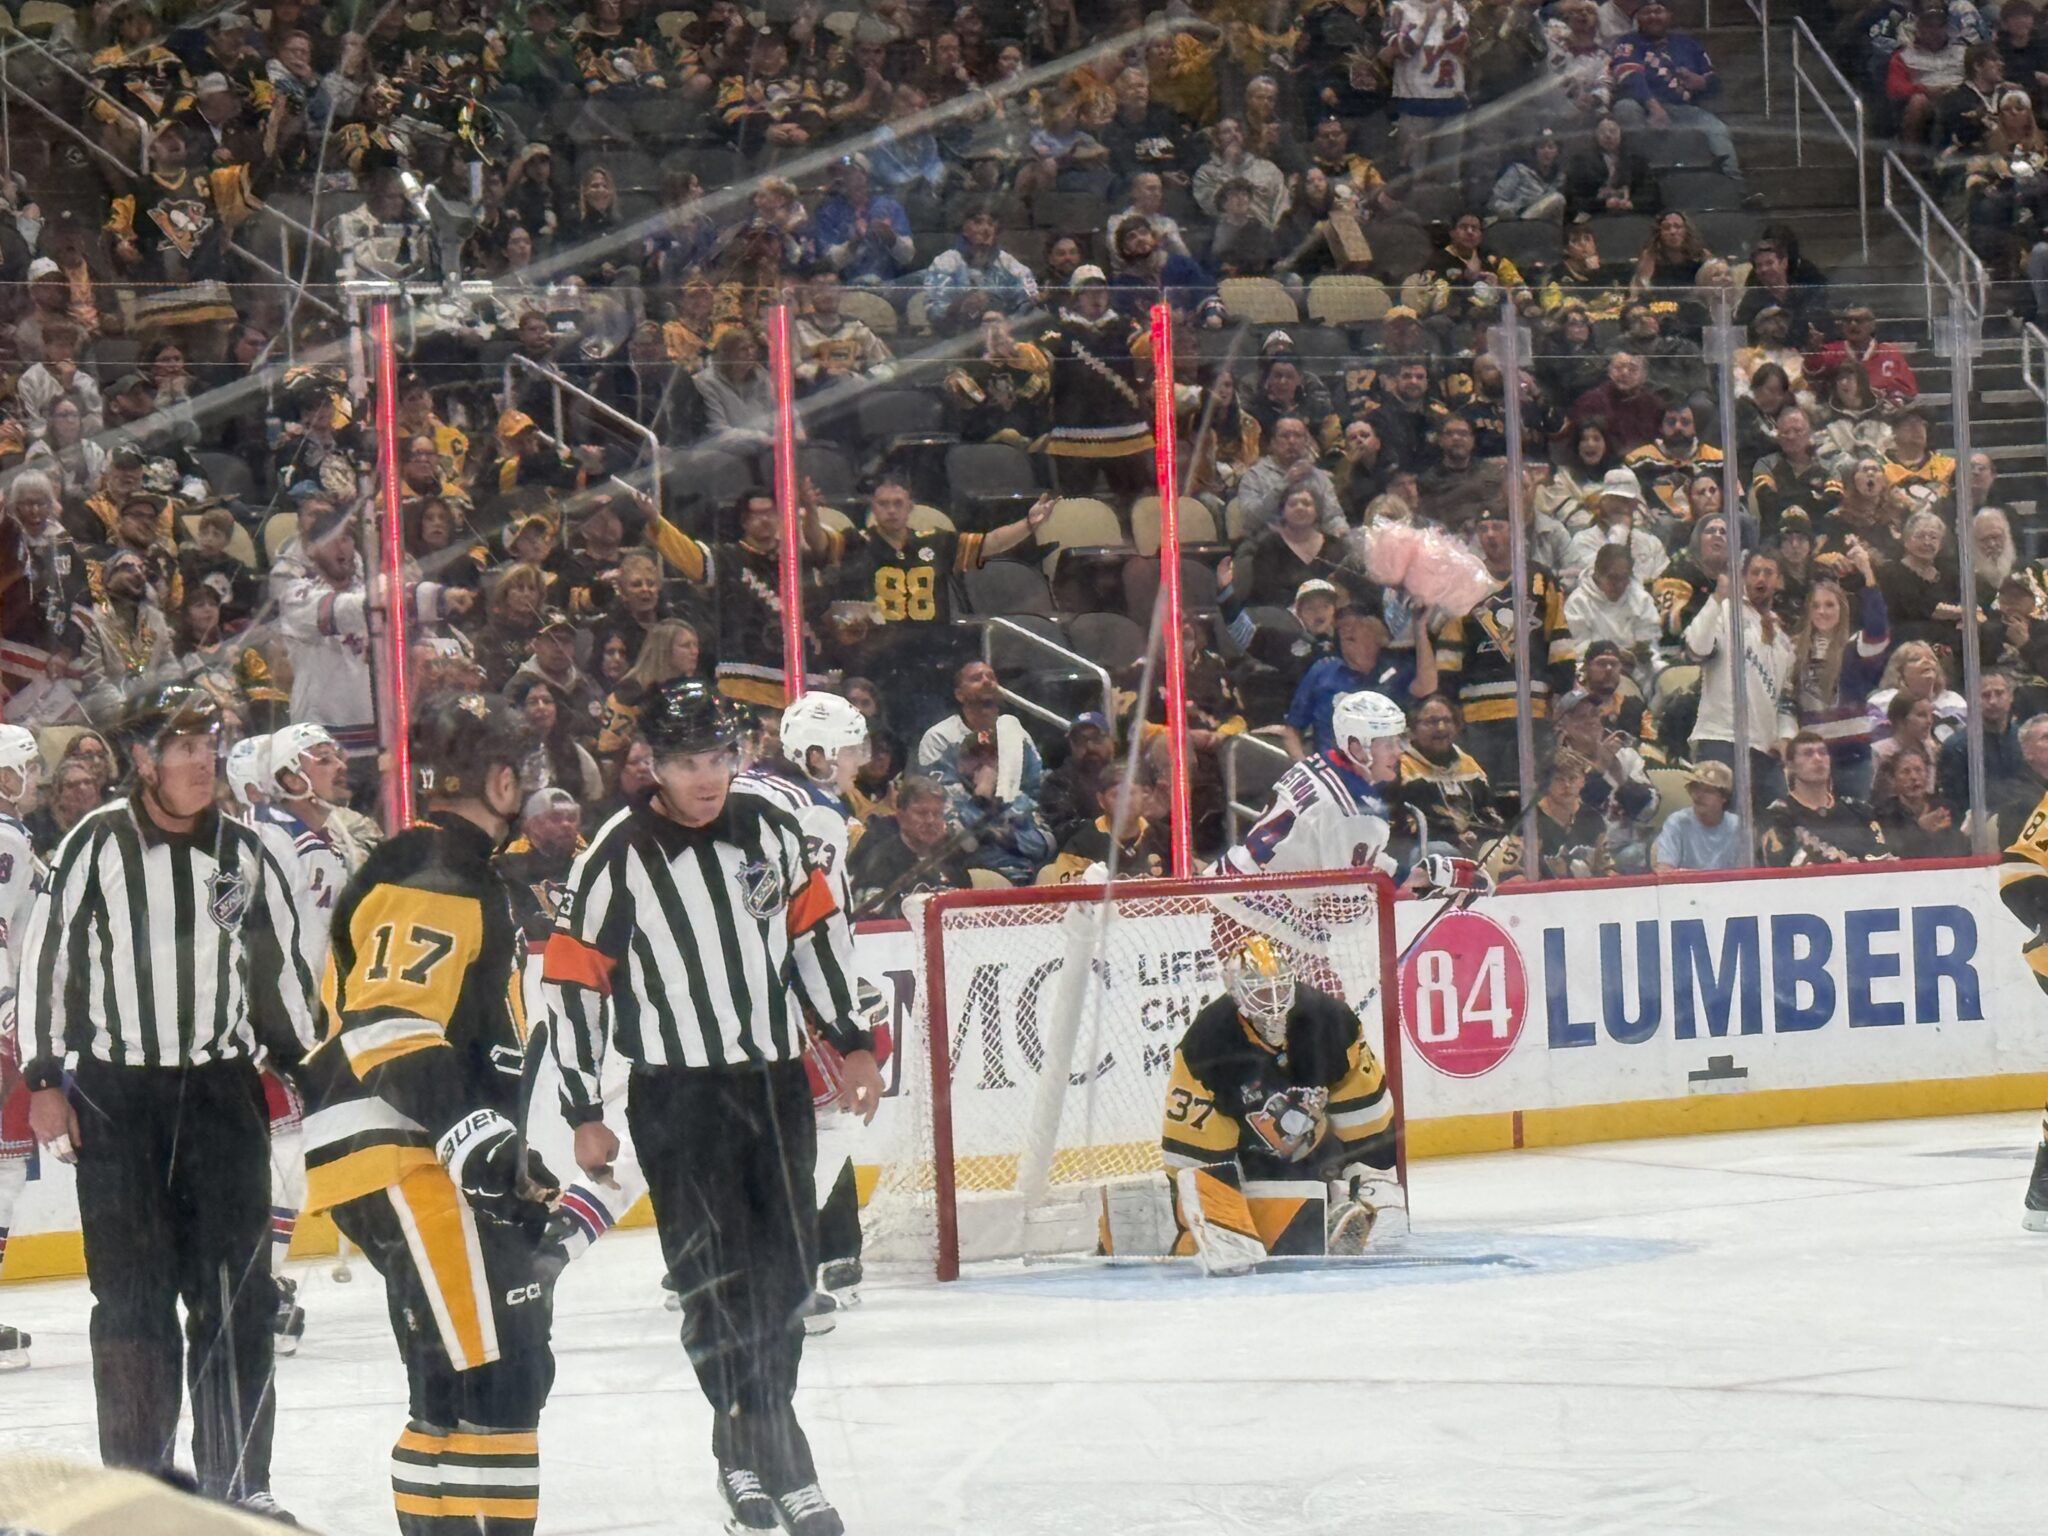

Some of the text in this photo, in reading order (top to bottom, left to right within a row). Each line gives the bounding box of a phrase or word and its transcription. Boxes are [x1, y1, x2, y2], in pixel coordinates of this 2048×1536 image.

[875, 566, 935, 620] 88
[420, 768, 434, 789] 17
[365, 922, 456, 987] 17
[1415, 904, 1986, 1050] 84 LUMBER
[1167, 1087, 1213, 1130] 37
